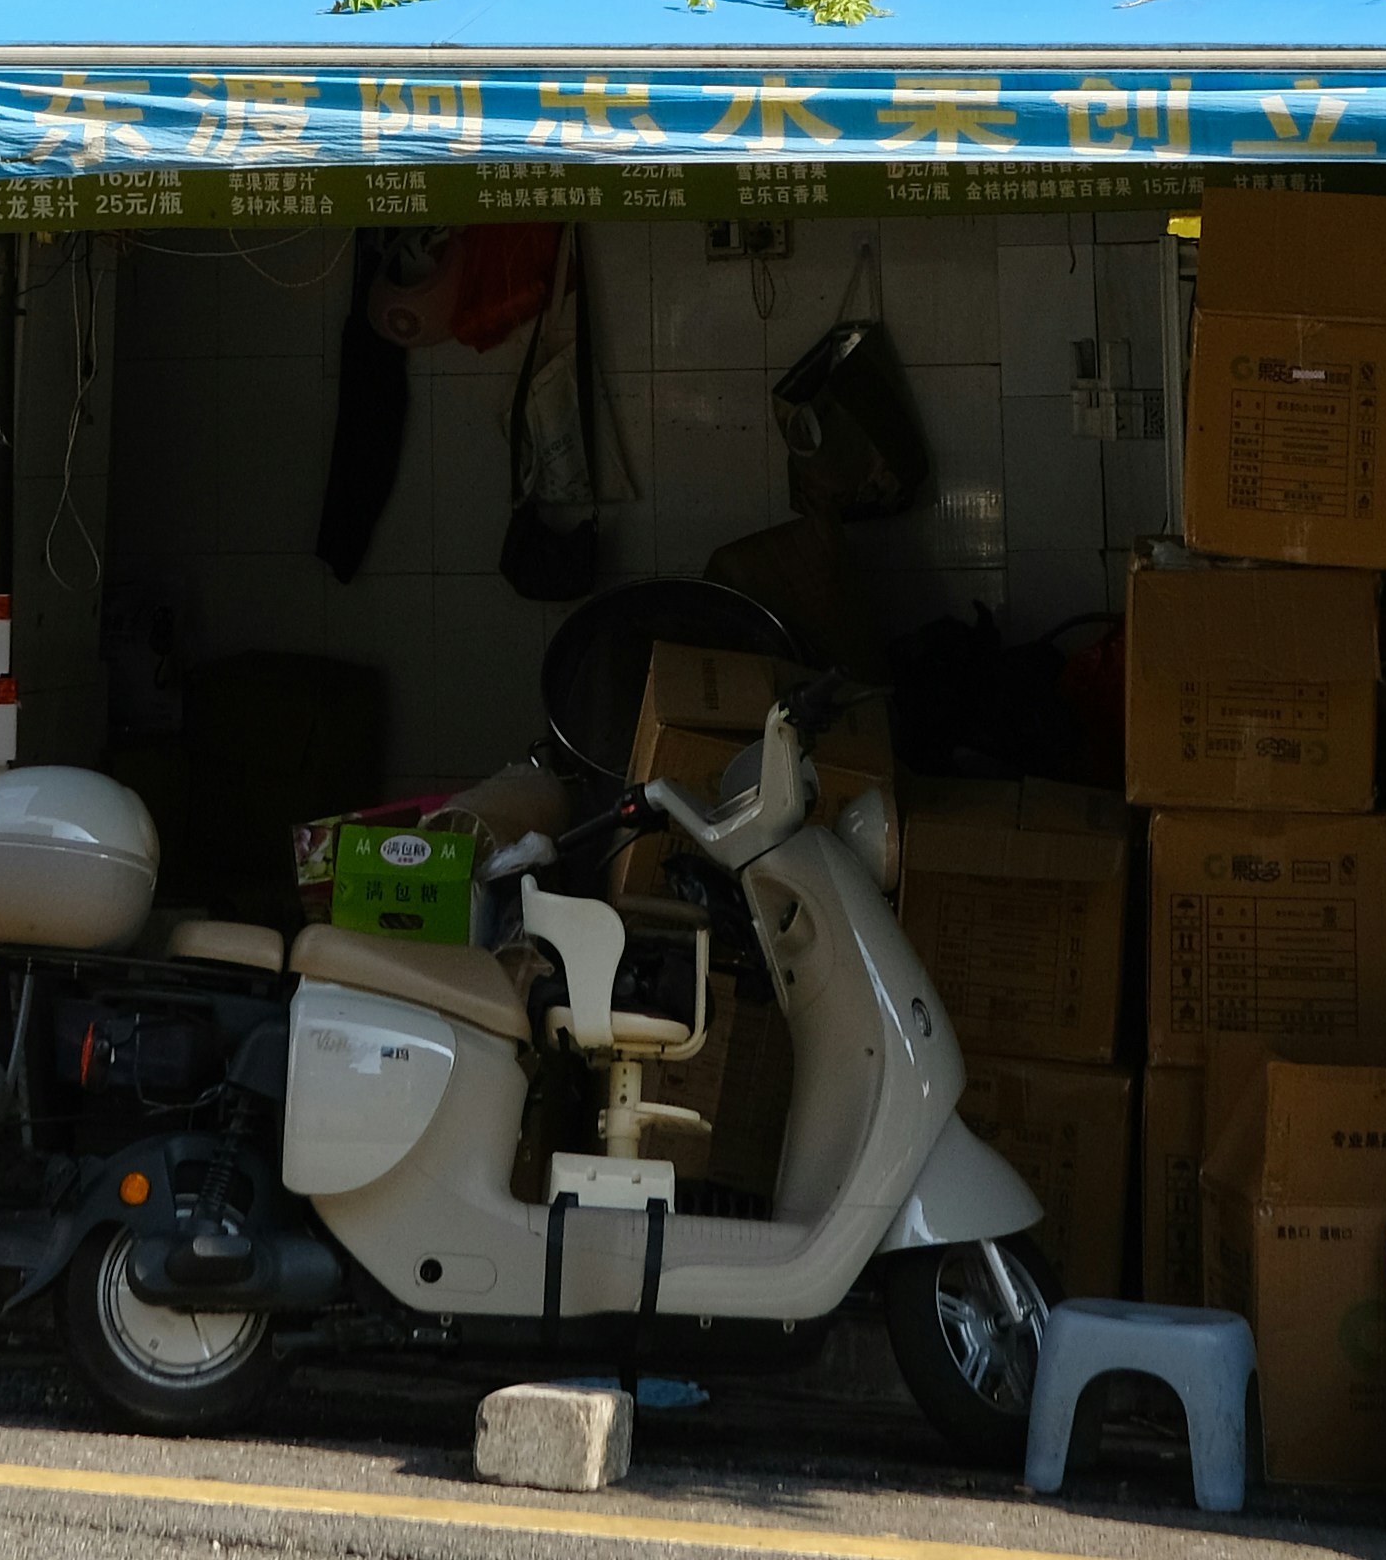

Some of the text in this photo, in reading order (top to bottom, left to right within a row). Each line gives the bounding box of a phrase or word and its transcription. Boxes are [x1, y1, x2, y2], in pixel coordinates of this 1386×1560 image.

[228, 172, 427, 192] 苹果菠萝汁 14元/瓶
[737, 182, 951, 205] 芭乐百香果 14元/瓶
[965, 175, 1206, 201] 金桔柠檬蜂蜜百香果 15元/瓶
[96, 191, 184, 216] 25元/瓶
[230, 194, 429, 216] 多种水果混合 12元/瓶
[478, 186, 687, 208] 牛油果香蕉奶昔 25元/瓶
[366, 880, 438, 903] 满包糖
